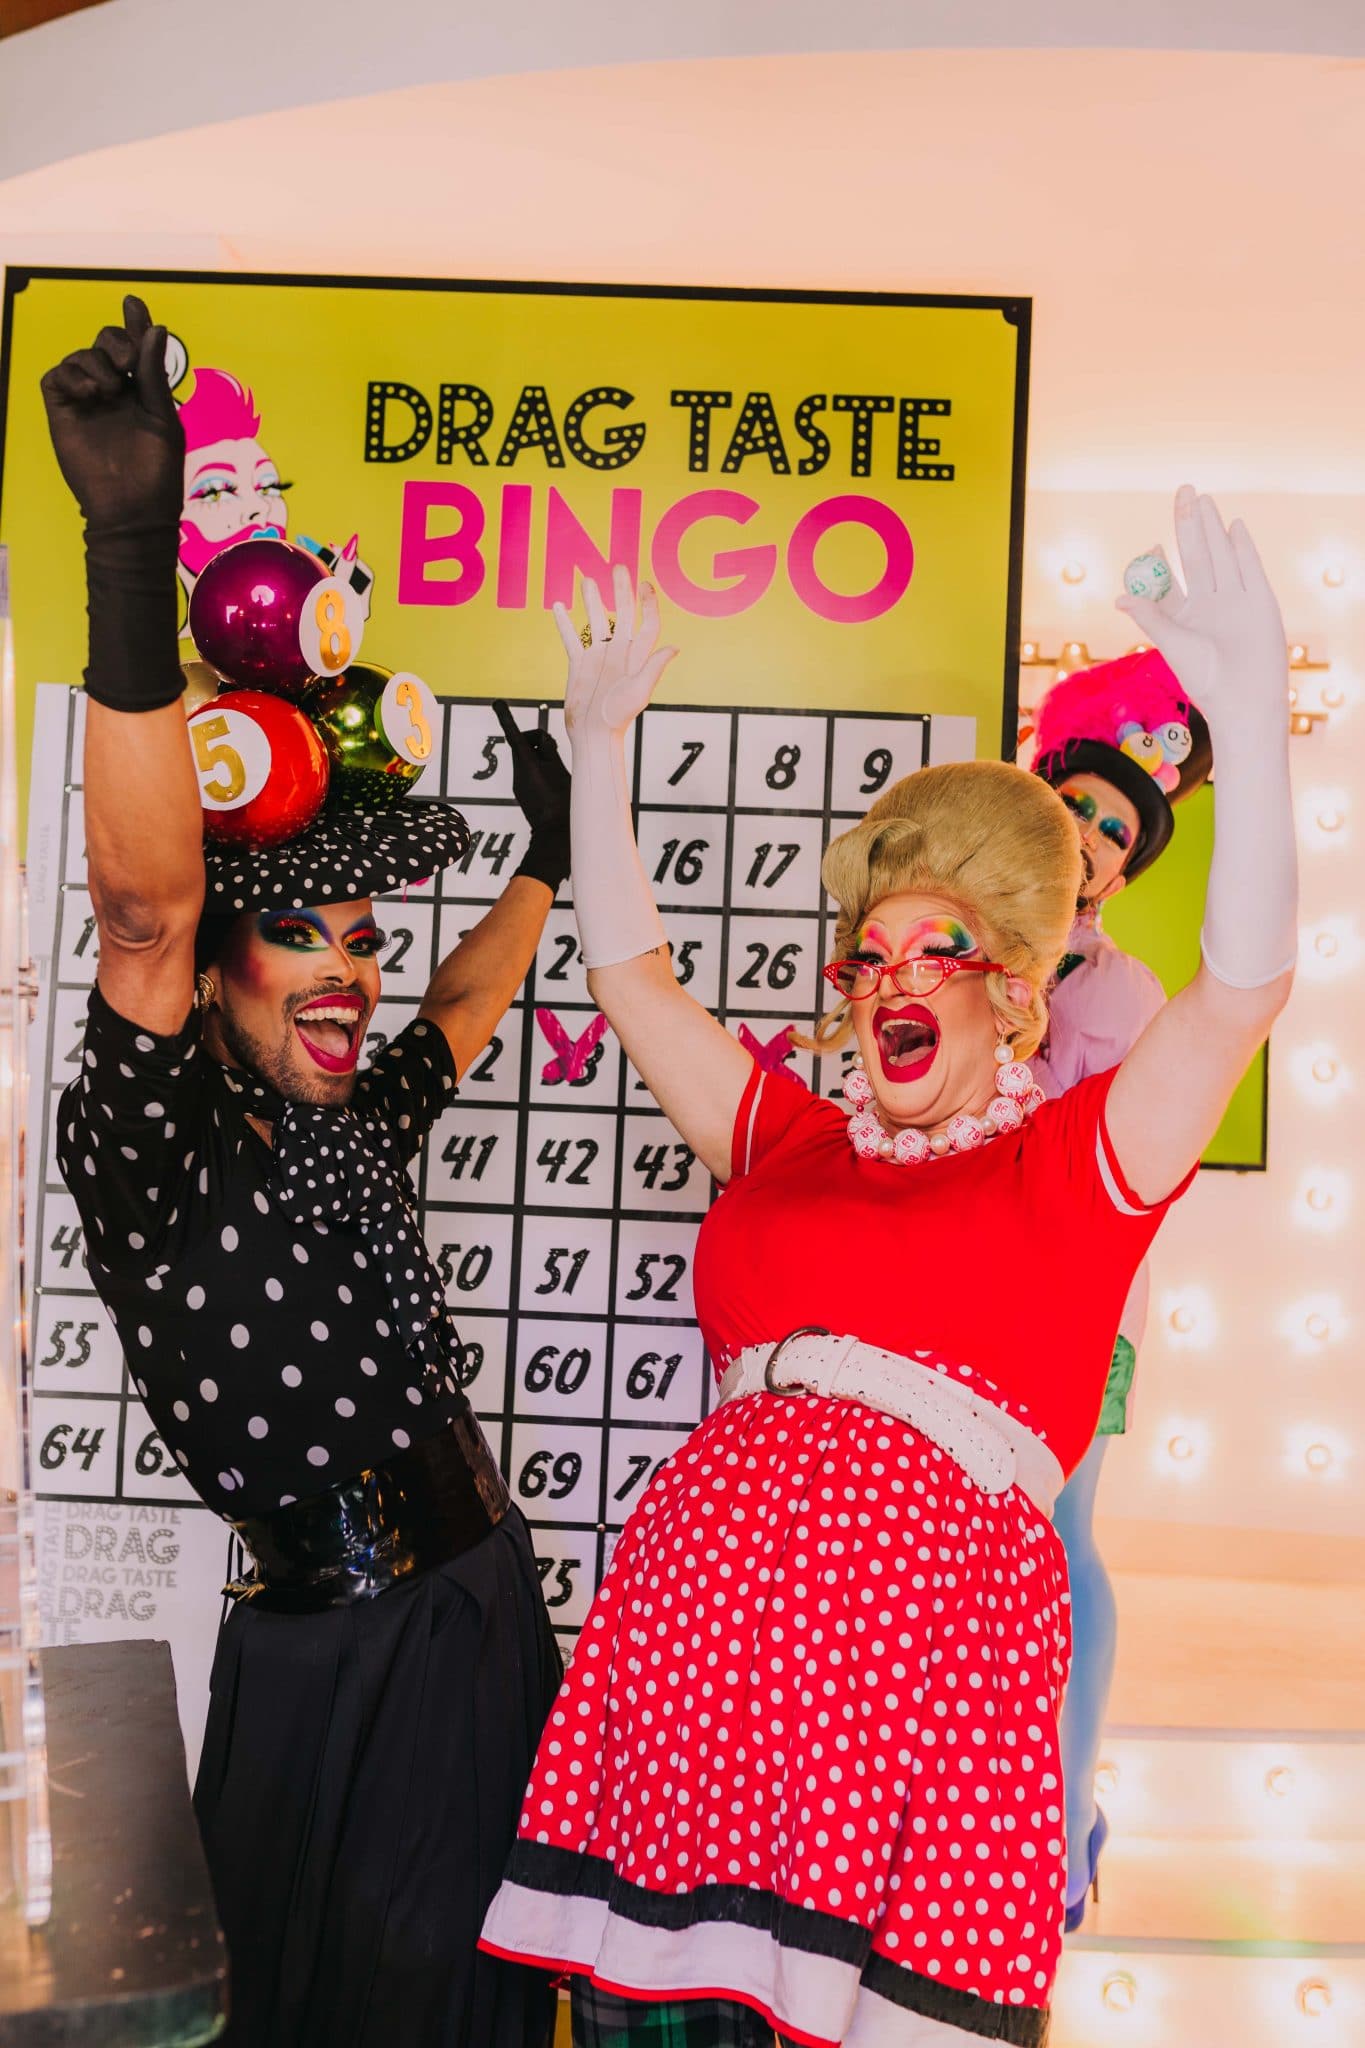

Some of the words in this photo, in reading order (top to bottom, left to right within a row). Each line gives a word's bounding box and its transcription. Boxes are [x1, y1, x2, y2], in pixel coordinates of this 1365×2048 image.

[364, 380, 646, 471] DRAG
[670, 389, 955, 482] TASTE
[397, 480, 914, 624] BINGO
[315, 588, 352, 671] 8
[395, 680, 433, 760] 3
[191, 714, 247, 803] 5
[472, 735, 506, 781] 5
[667, 742, 705, 787] 7
[765, 743, 801, 791] 8
[859, 748, 894, 795] 9
[457, 830, 516, 876] 14
[652, 838, 710, 886] 16
[744, 842, 801, 888] 17
[544, 935, 584, 981] 2
[668, 941, 702, 986] 5
[736, 942, 803, 989] 26
[440, 1134, 499, 1182] 41
[536, 1138, 599, 1185] 42
[633, 1143, 697, 1191] 43
[50, 1225, 88, 1269] 4
[436, 1243, 493, 1292] 50
[534, 1247, 590, 1296] 51
[625, 1253, 687, 1302] 52
[39, 1320, 99, 1368] 55
[523, 1344, 592, 1395] 60
[625, 1351, 684, 1401] 61
[39, 1423, 106, 1472] 64
[517, 1450, 583, 1500] 69
[65, 1502, 122, 1521] DRAG
[128, 1507, 182, 1525] TASTE
[64, 1523, 180, 1565] DRAG
[62, 1565, 118, 1585] DRAG
[120, 1568, 178, 1589] TASTE
[57, 1586, 157, 1621] DRAG
